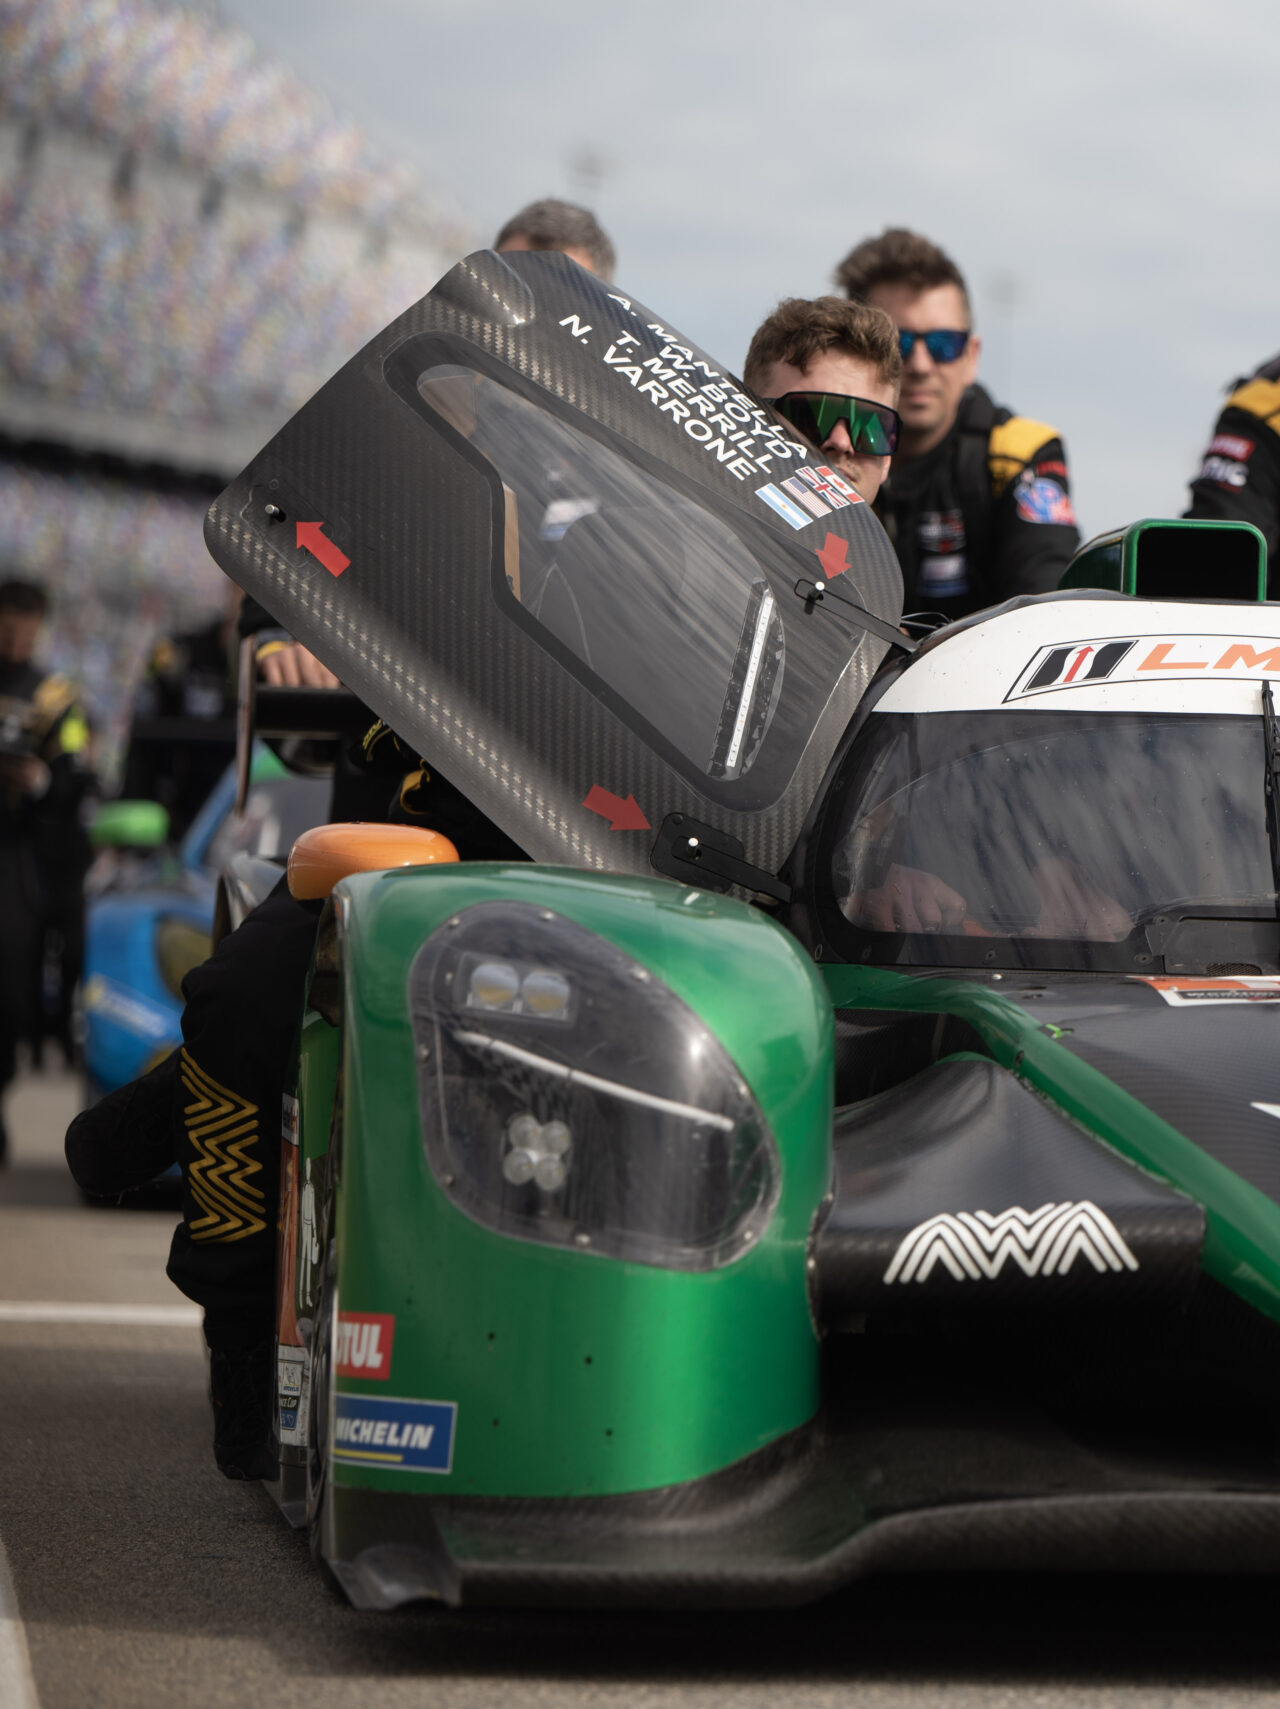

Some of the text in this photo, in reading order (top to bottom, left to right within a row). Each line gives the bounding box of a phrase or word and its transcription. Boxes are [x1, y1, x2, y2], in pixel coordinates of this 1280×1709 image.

[559, 314, 757, 481] N. VARRONE
[607, 293, 808, 460] A. MANTELLA
[616, 330, 773, 475] T. MERRILL
[659, 345, 792, 459] W. BOYD
